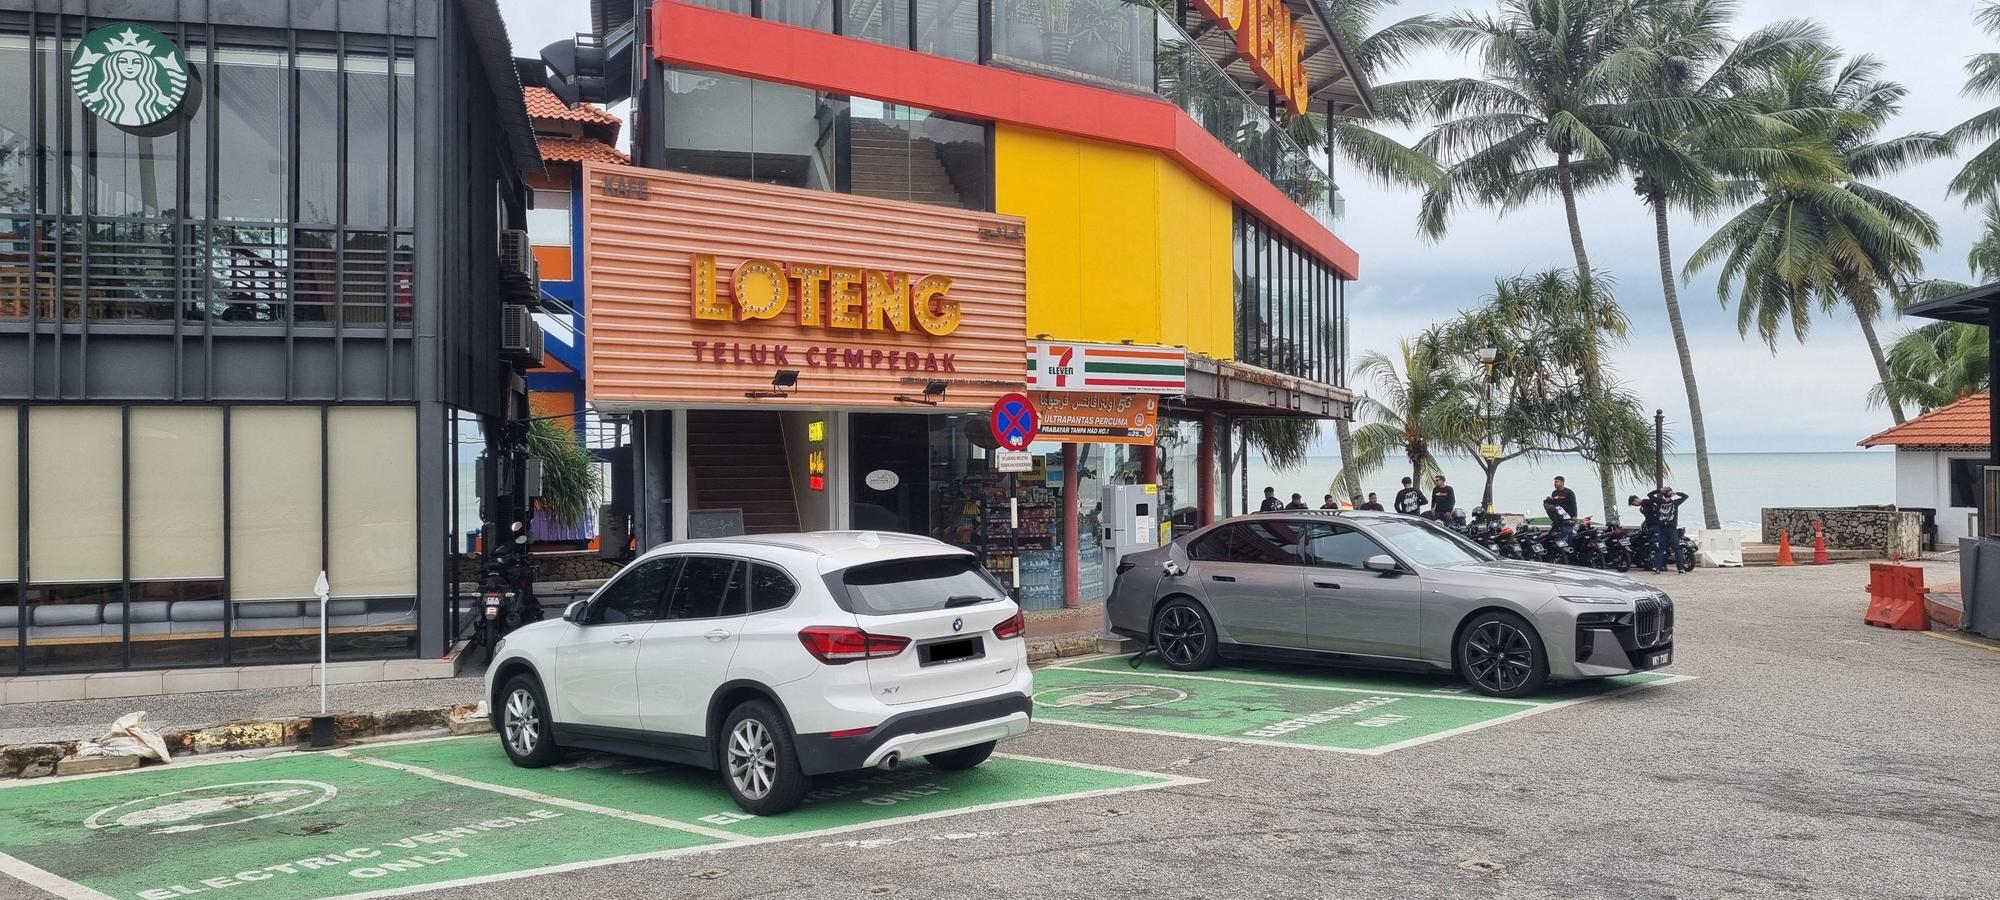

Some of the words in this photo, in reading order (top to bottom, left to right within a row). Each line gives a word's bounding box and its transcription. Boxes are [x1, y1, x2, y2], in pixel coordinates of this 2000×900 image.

[602, 176, 648, 200] KAFE
[690, 253, 961, 336] LOTENG
[692, 341, 789, 366] TELUK
[807, 346, 956, 372] CEMPEDAK
[1049, 345, 1073, 387] 7
[1117, 395, 1133, 413] 5G
[1041, 426, 1070, 434] PRABAYAR
[1044, 414, 1094, 425] ULTRAPANTAS
[1095, 416, 1128, 426] PERCUMA
[136, 847, 381, 900] ELECTRIC
[381, 809, 565, 850] VEHICLE
[349, 847, 469, 878] ONLY
